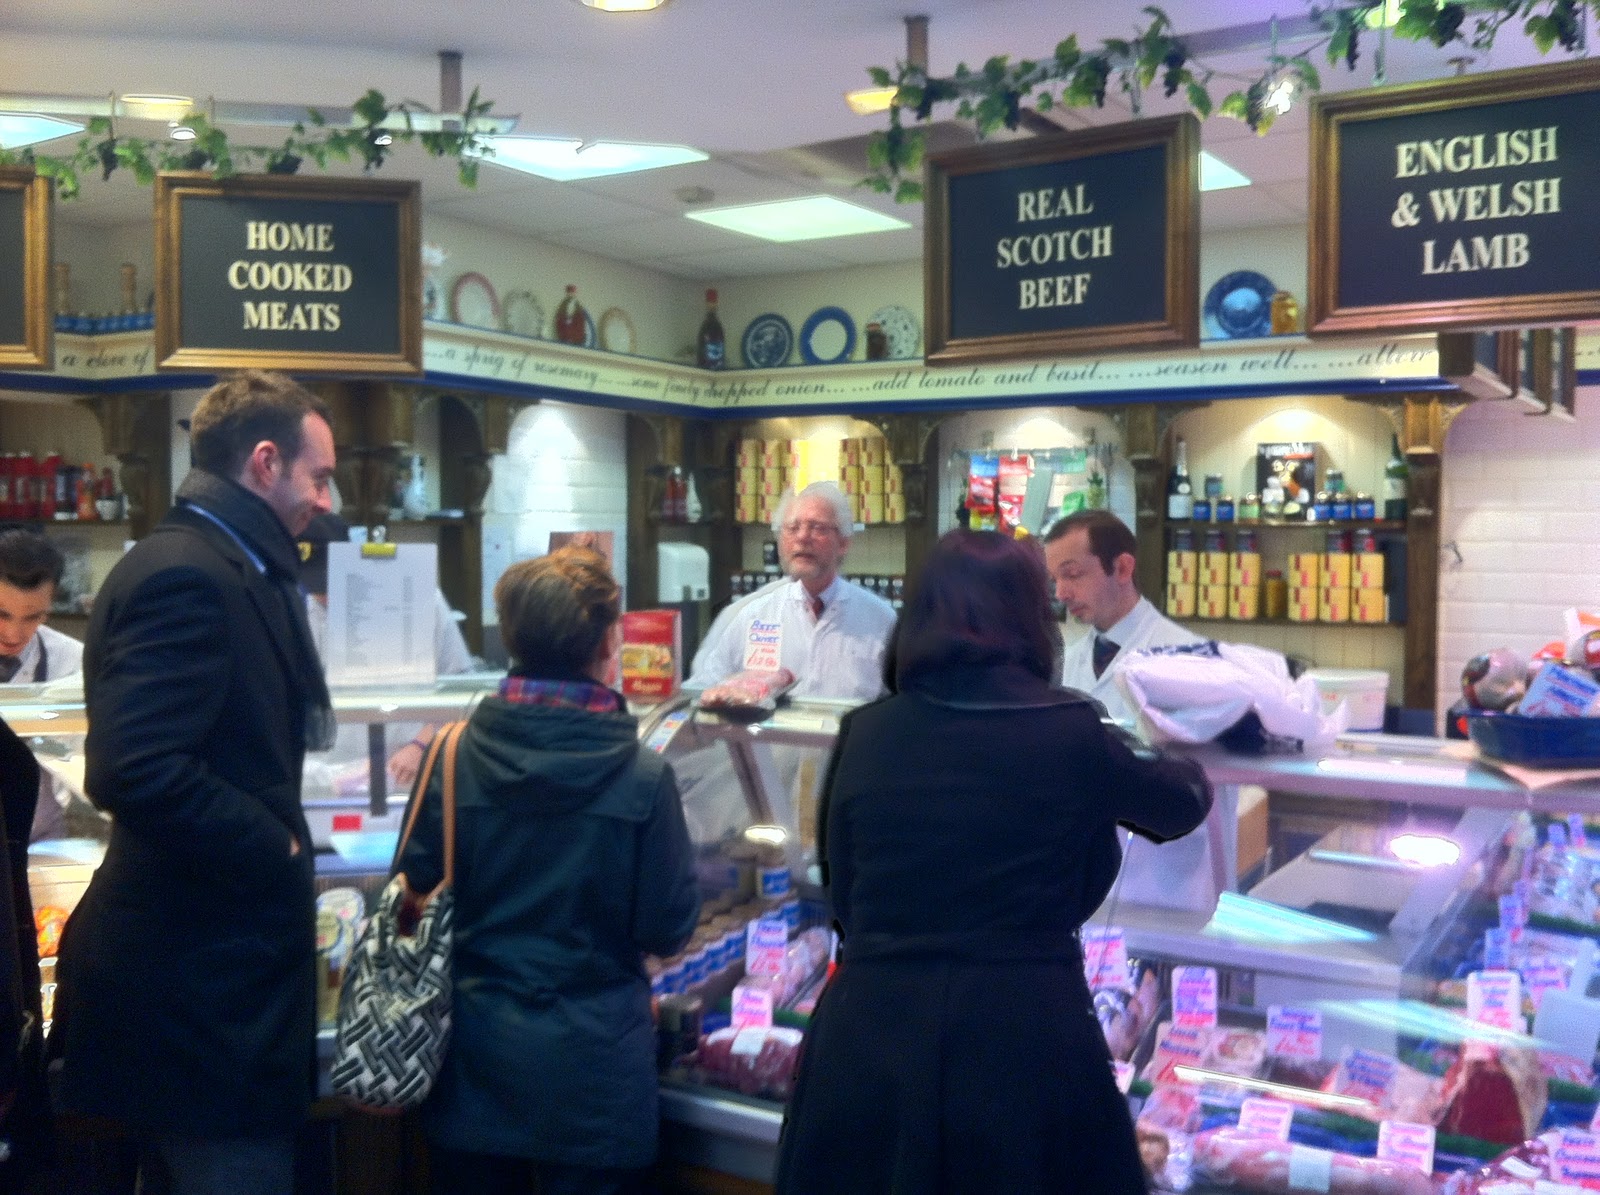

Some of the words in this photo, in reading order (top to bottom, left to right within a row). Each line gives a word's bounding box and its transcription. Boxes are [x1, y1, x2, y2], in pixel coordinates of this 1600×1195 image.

[1395, 126, 1558, 179] ENGLISH
[1017, 184, 1095, 224] REAL
[1391, 190, 1420, 228] &
[1430, 178, 1562, 222] WELSH
[246, 221, 334, 252] HOME
[997, 226, 1113, 269] SCOTCH
[1423, 232, 1530, 276] LAMB
[228, 260, 353, 292] COOKED
[1019, 273, 1092, 311] BEEF
[243, 301, 341, 332] MEATS
[511, 352, 530, 378] of
[704, 378, 771, 406] chopped
[918, 367, 985, 389] tomato
[994, 364, 1039, 385] and
